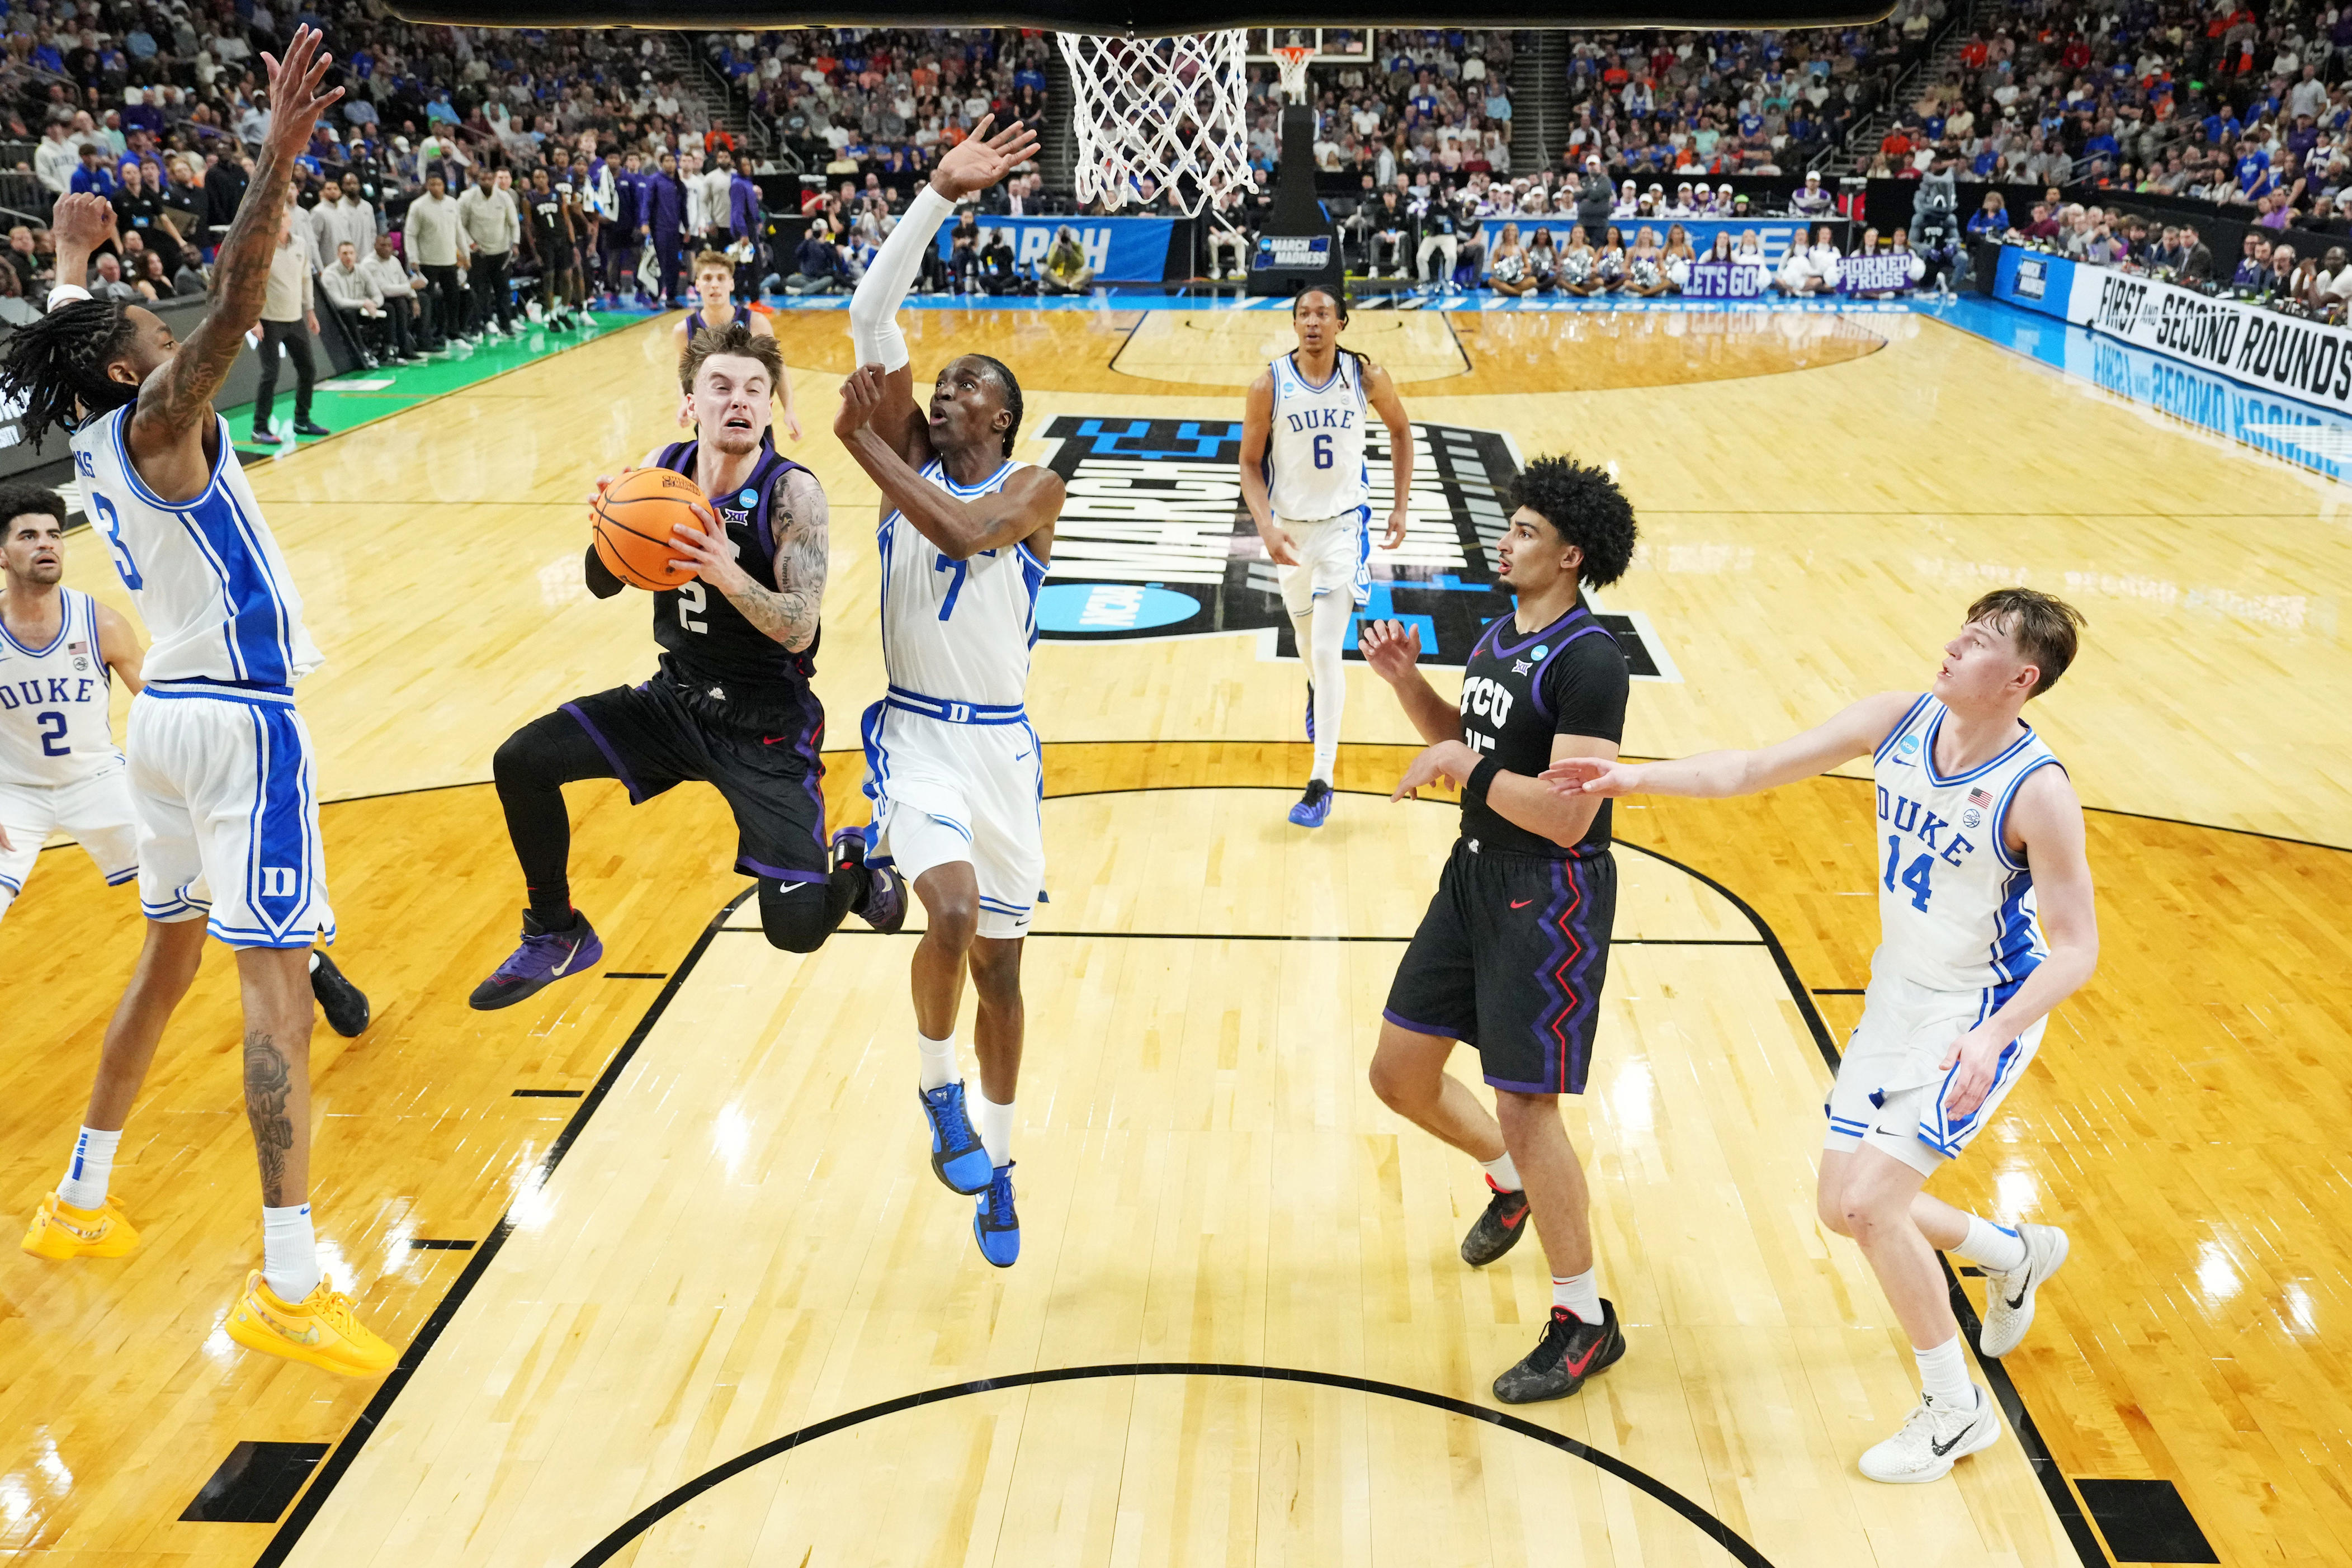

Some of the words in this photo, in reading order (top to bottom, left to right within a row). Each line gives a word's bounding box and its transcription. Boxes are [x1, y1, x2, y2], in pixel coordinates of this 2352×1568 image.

[1271, 239, 1310, 252] MARCH
[1274, 251, 1328, 265] MADNESS
[1838, 254, 1911, 277] HORNED
[1845, 270, 1905, 291] FROGS
[1729, 266, 1757, 297] GO
[2099, 276, 2147, 334] FIRST
[2140, 303, 2159, 327] AND
[2156, 293, 2241, 366] SECOND
[2236, 315, 2352, 402] ROUNDS
[1287, 409, 1354, 432] DUKE
[1314, 434, 1333, 470] 6
[741, 495, 757, 505] NCAA
[727, 511, 747, 523] XII
[92, 492, 143, 591] 3
[935, 553, 967, 621] 7
[678, 580, 708, 635] 2
[1079, 585, 1147, 627] NCAA
[1514, 661, 1528, 673] XII
[0, 678, 94, 710] DUKE
[1460, 676, 1514, 730] TCU
[948, 703, 970, 723] D
[37, 711, 71, 757] 2
[1901, 740, 1915, 753] NCAA
[1877, 784, 1975, 867] DUKE
[1966, 814, 1980, 824] ACC
[262, 867, 296, 897] D
[1883, 834, 1935, 914] 14
